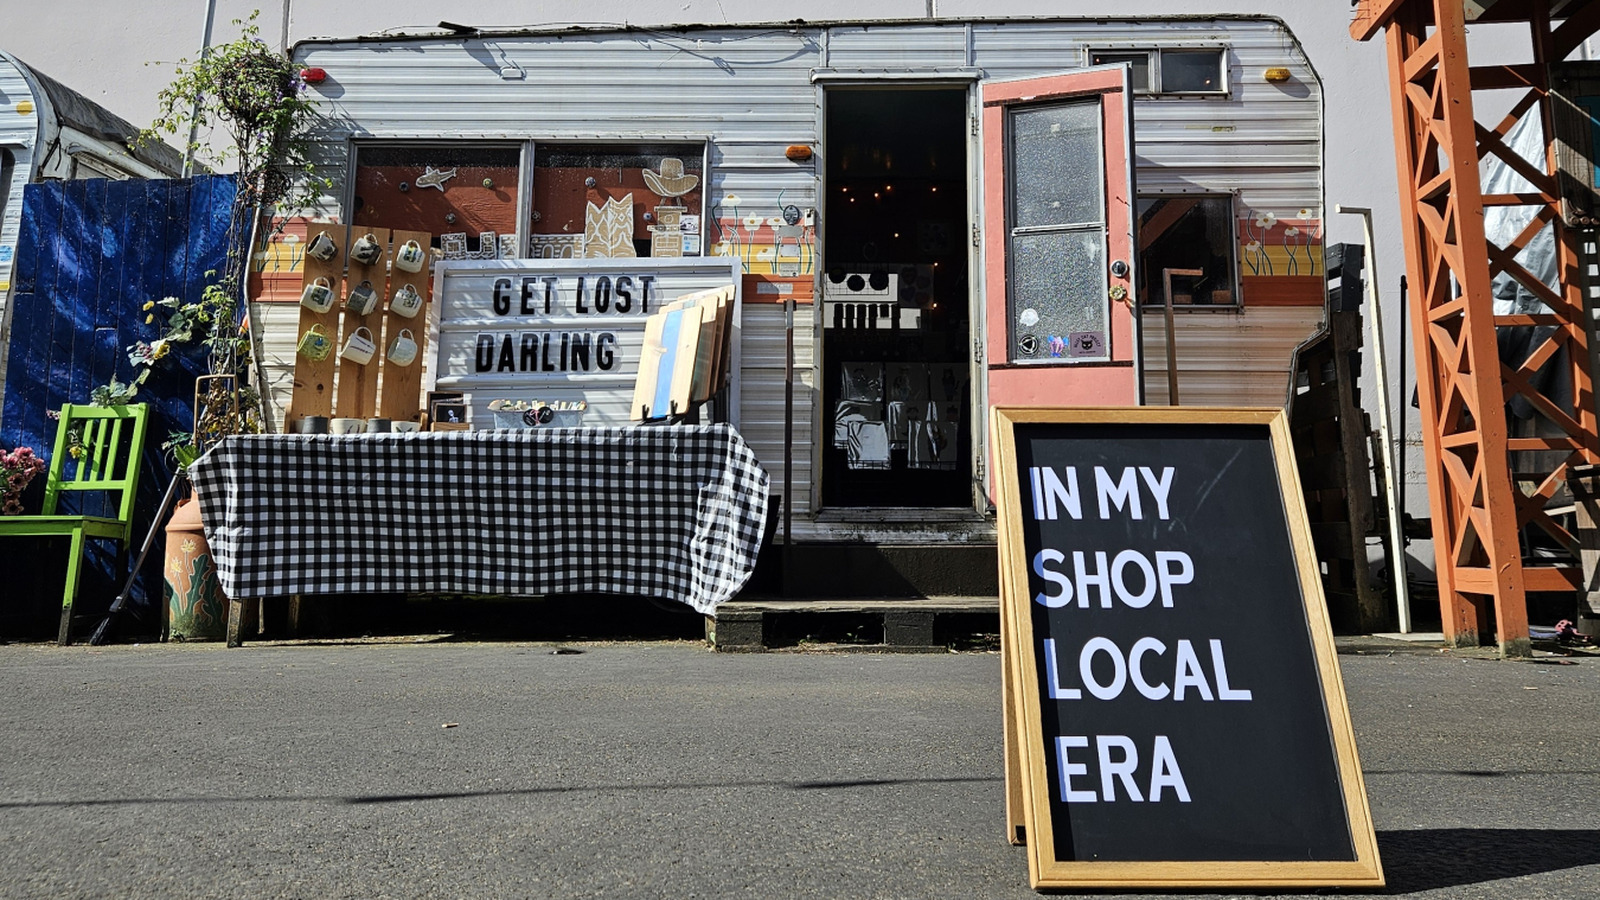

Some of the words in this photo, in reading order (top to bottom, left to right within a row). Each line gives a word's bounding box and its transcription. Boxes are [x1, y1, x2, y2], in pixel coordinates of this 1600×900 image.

[493, 277, 558, 316] GET
[576, 276, 654, 314] LOST
[475, 332, 614, 372] DARLING
[1029, 466, 1083, 520] IN
[1094, 466, 1175, 520] MY
[1033, 548, 1195, 609] SHOP
[1043, 636, 1253, 701] LOCAL
[1054, 735, 1192, 803] ERA
